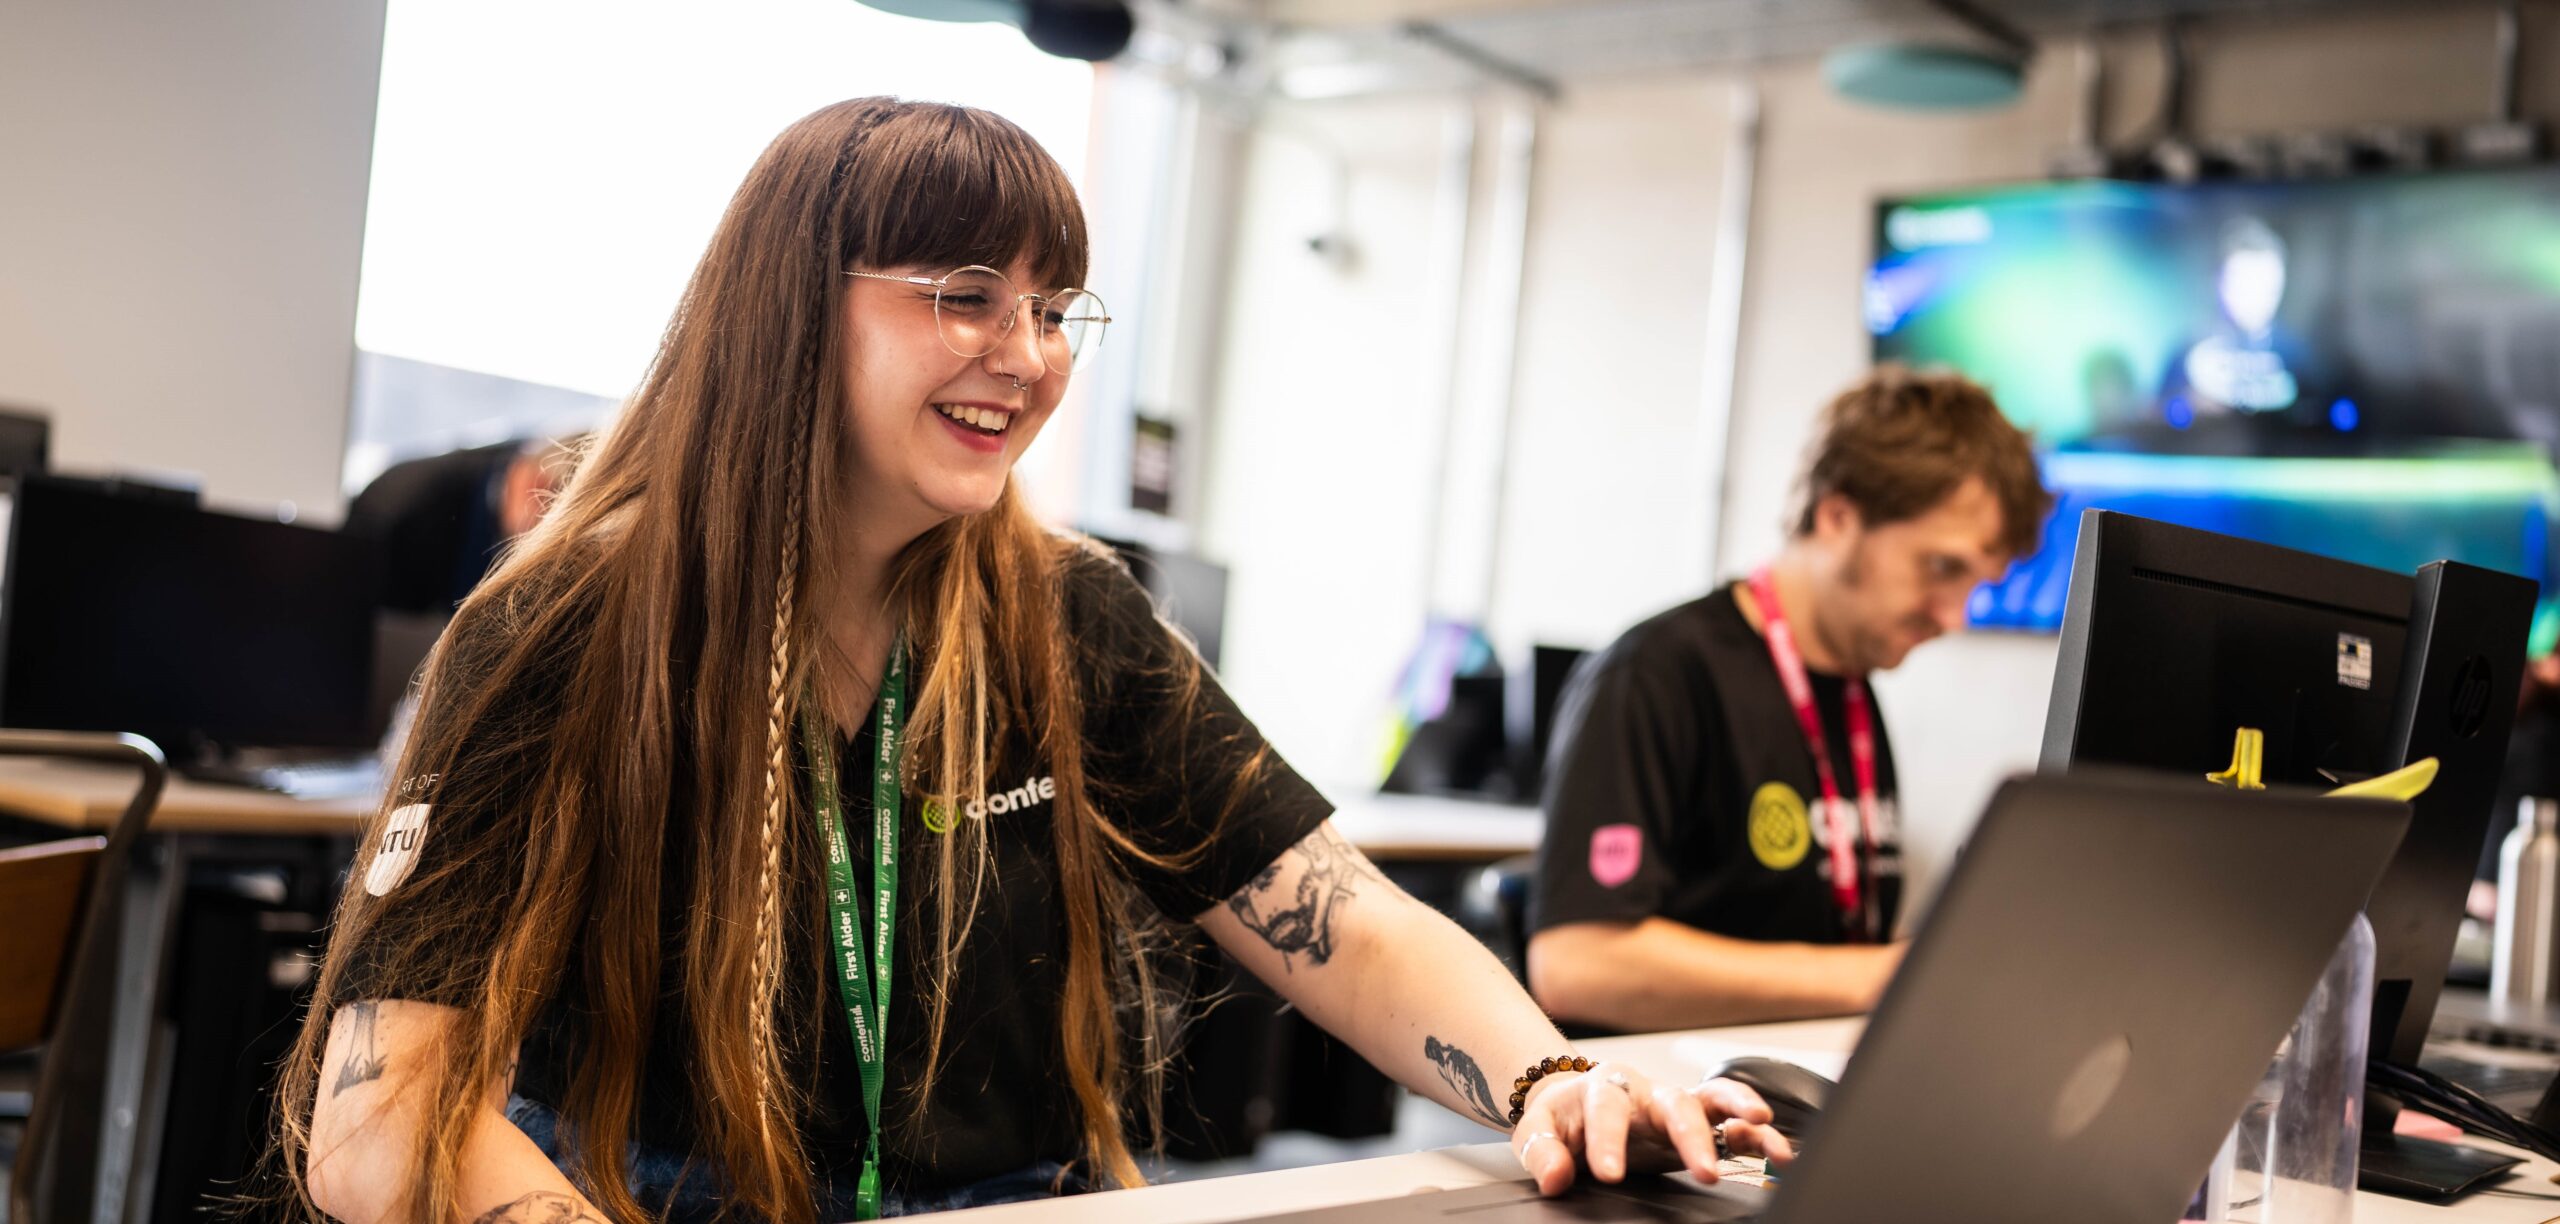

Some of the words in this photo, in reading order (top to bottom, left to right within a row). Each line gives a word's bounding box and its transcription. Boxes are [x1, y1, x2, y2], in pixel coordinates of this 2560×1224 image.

[883, 697, 896, 725] First
[881, 728, 895, 763] Aider
[402, 777, 416, 793] RT
[417, 773, 440, 789] OF
[965, 777, 1056, 820] confe
[880, 889, 891, 919] First
[840, 911, 855, 948] Aider
[878, 921, 889, 959] Aider
[847, 950, 859, 980] First
[854, 1015, 871, 1063] confetti
